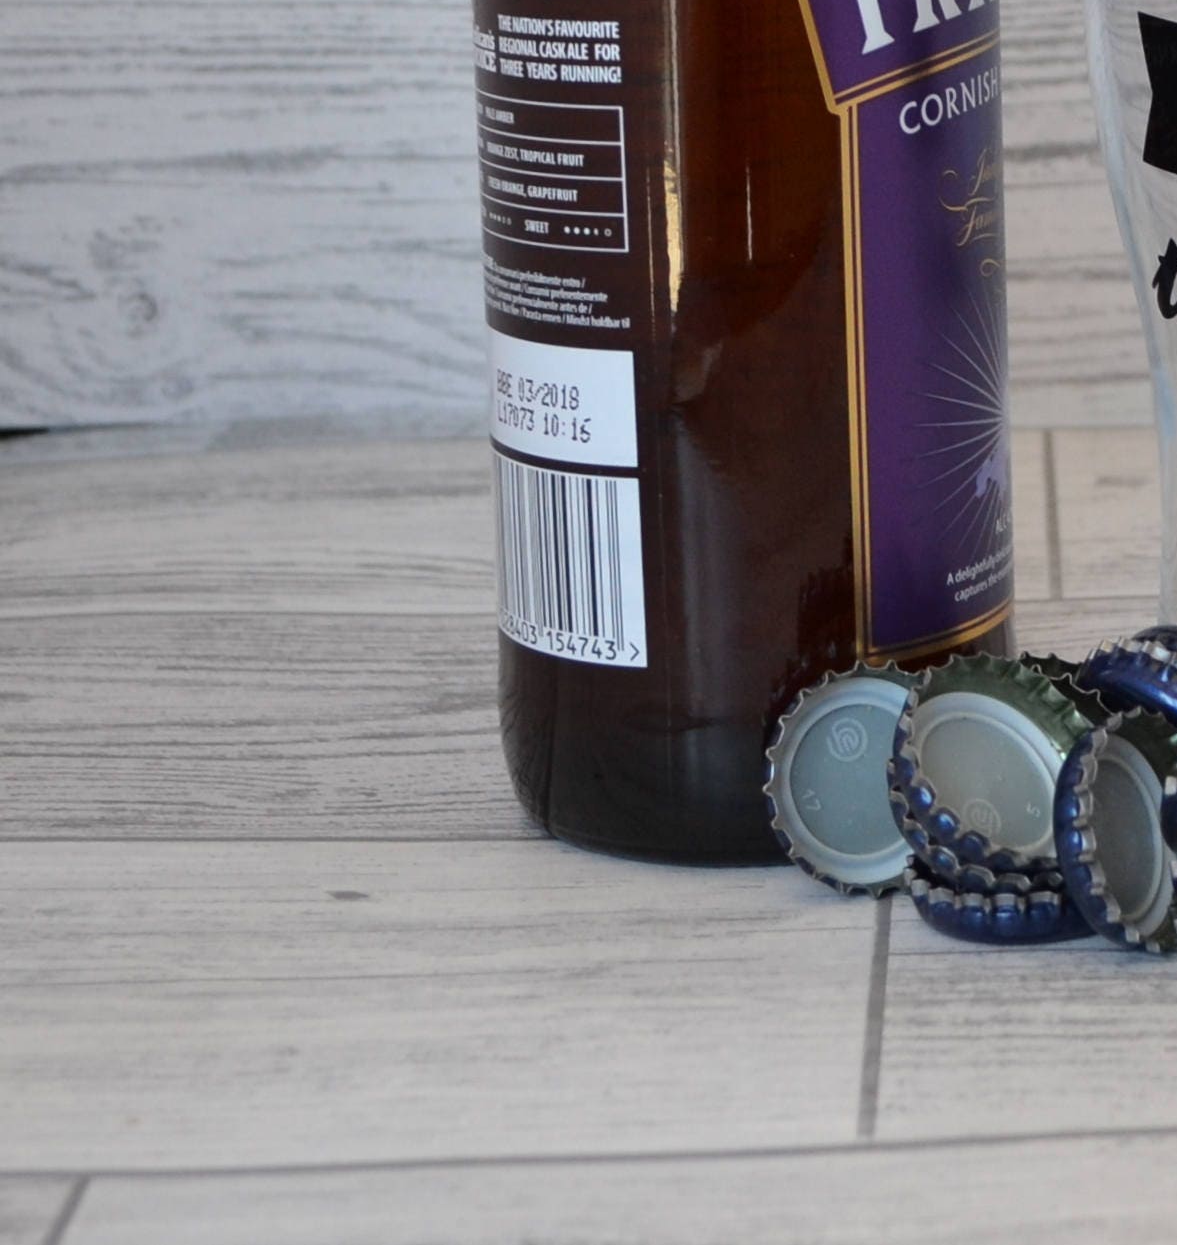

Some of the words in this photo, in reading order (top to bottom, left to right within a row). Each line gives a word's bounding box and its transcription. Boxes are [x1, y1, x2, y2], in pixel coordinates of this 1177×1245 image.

[497, 14, 512, 30] THE
[512, 15, 553, 37] NATION'S
[554, 19, 620, 40] FAVOURITE
[498, 37, 538, 57] REGIONAL
[567, 42, 589, 61] ALE
[594, 43, 621, 62] FOR
[499, 58, 525, 79] THREE
[526, 62, 558, 82] YEARS
[560, 64, 623, 84] RUNNING!
[899, 66, 998, 135] CORNISH
[520, 147, 556, 166] TROPICAL
[557, 153, 584, 168] FRUIT
[527, 183, 579, 202] GRAPEFRUIT
[524, 219, 550, 234] SWEET
[517, 376, 580, 411] 03/2018
[497, 399, 535, 432] L17073
[546, 630, 617, 661] 154743
